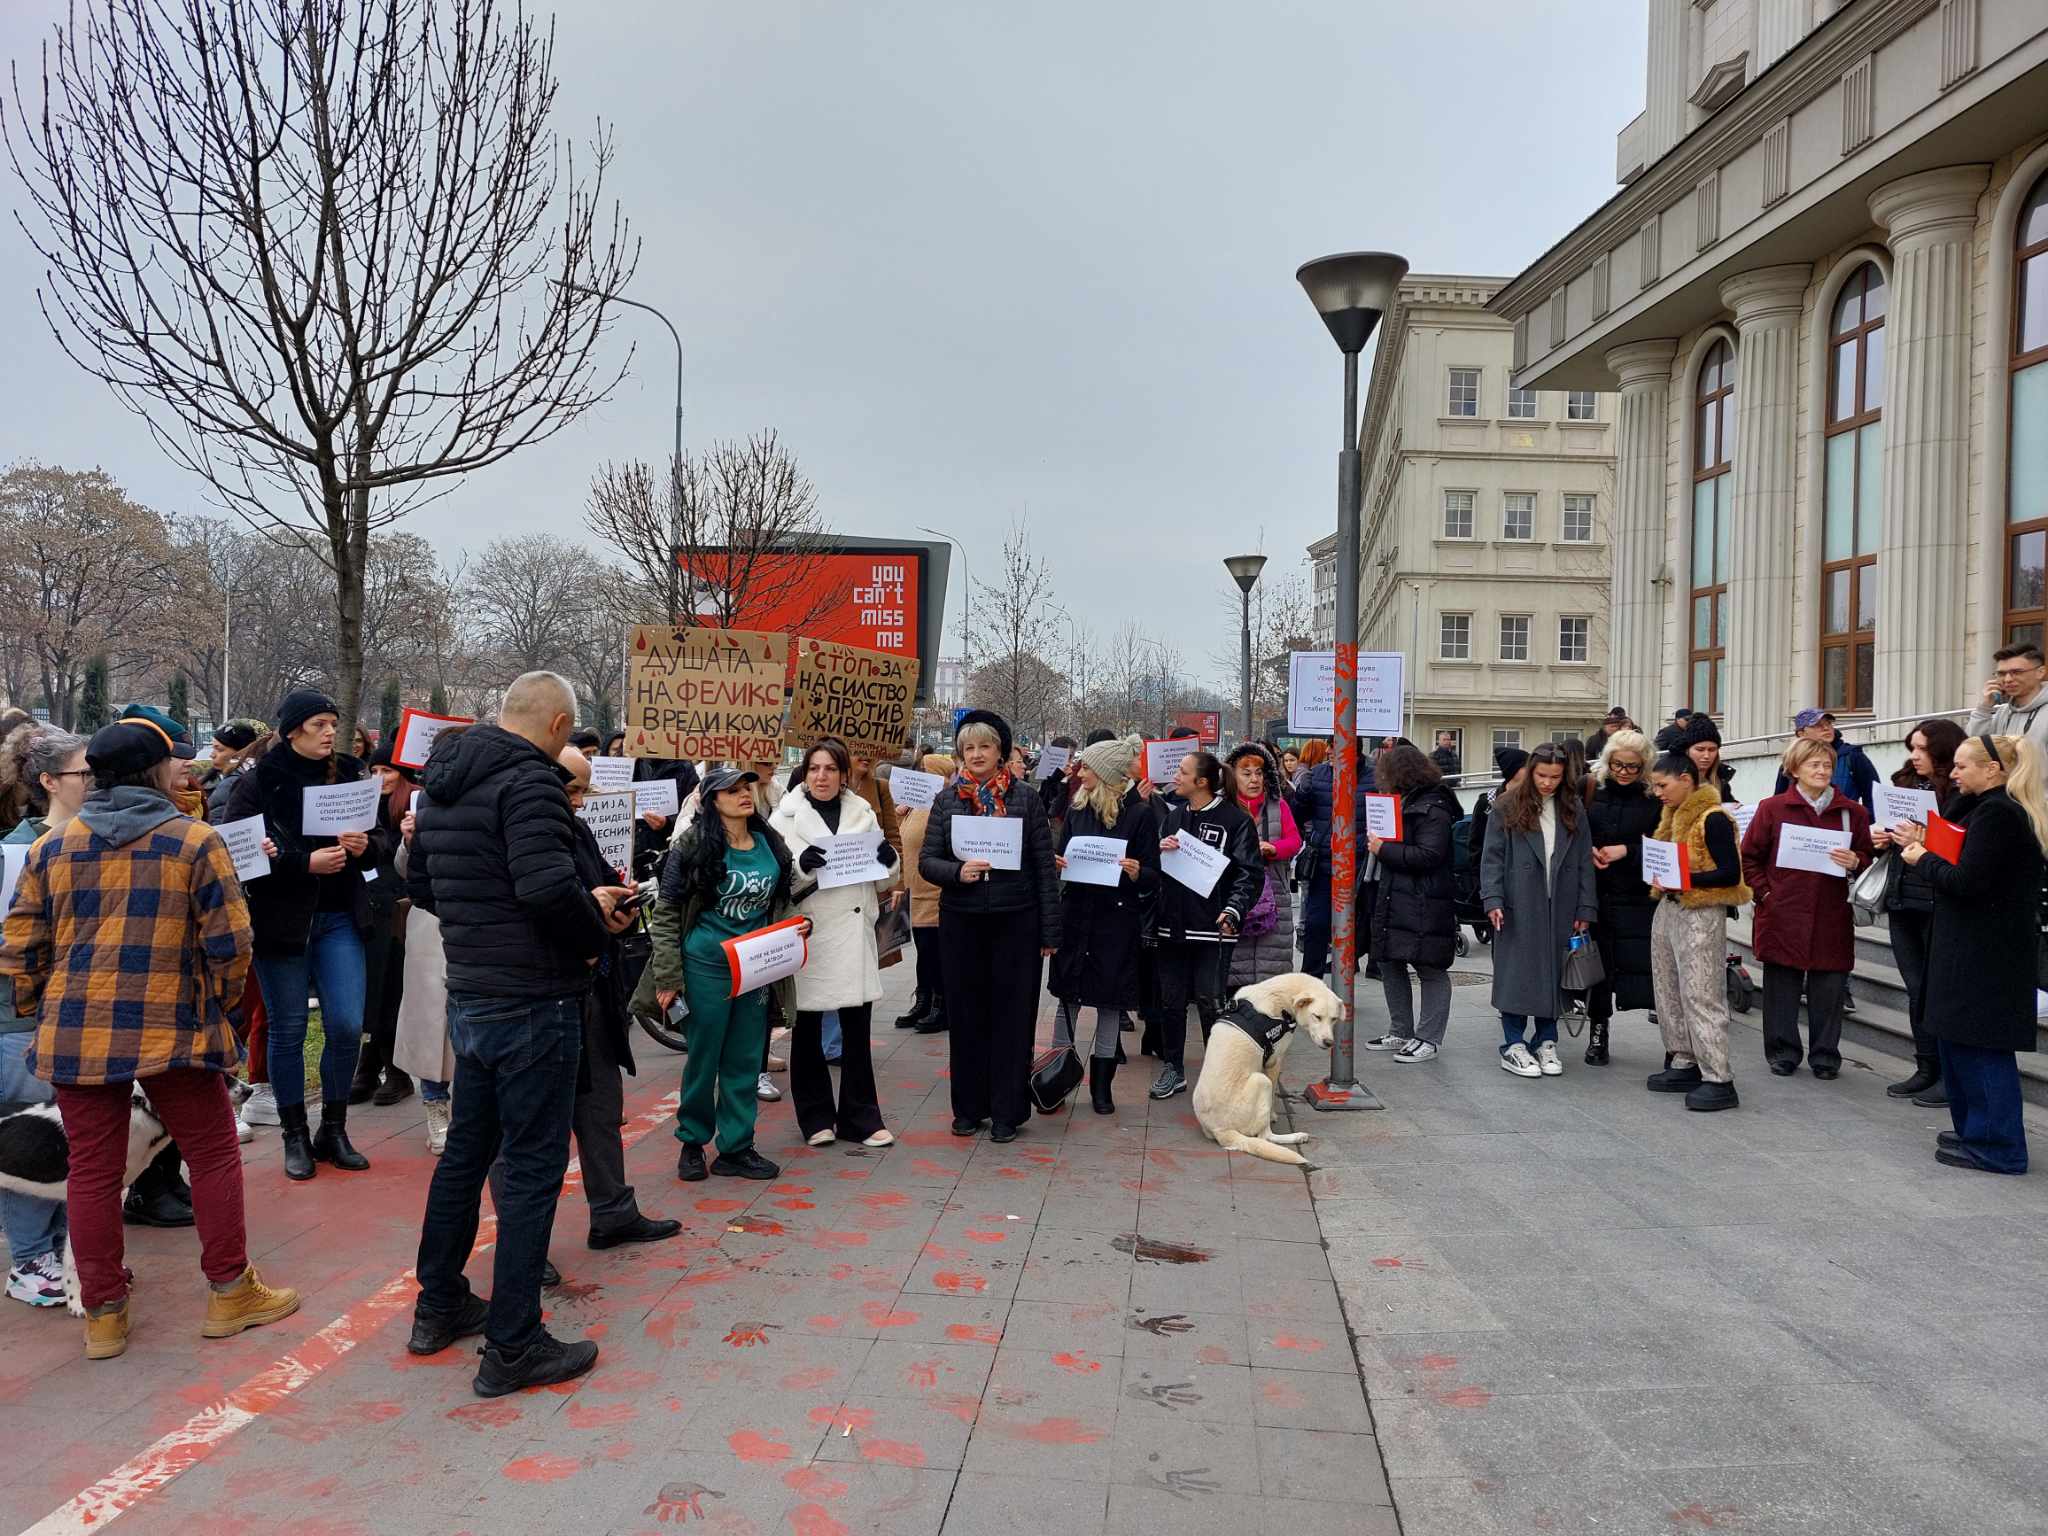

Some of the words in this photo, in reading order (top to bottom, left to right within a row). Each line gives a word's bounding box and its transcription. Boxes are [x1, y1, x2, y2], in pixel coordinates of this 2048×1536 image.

[872, 566, 904, 587] you
[853, 585, 904, 604] can't
[860, 604, 904, 626] miss
[876, 631, 904, 647] me
[641, 645, 753, 675] ДУШАТА
[814, 651, 872, 677] СТОП
[880, 660, 902, 679] ЗА
[637, 680, 673, 704] НА
[676, 679, 781, 707] ФЕЛИКС
[799, 670, 908, 702] НАСИЛСТВО
[643, 707, 720, 736] ВРЕДИ
[726, 712, 784, 738] КОЛКУ
[827, 695, 905, 723] ПРОТИВ
[807, 711, 906, 744] ЖИВОТНИ
[666, 732, 784, 760] ЧОВЕЧКАТА!
[583, 799, 627, 812] УДИЈА,
[600, 812, 632, 823] БИДЕШ
